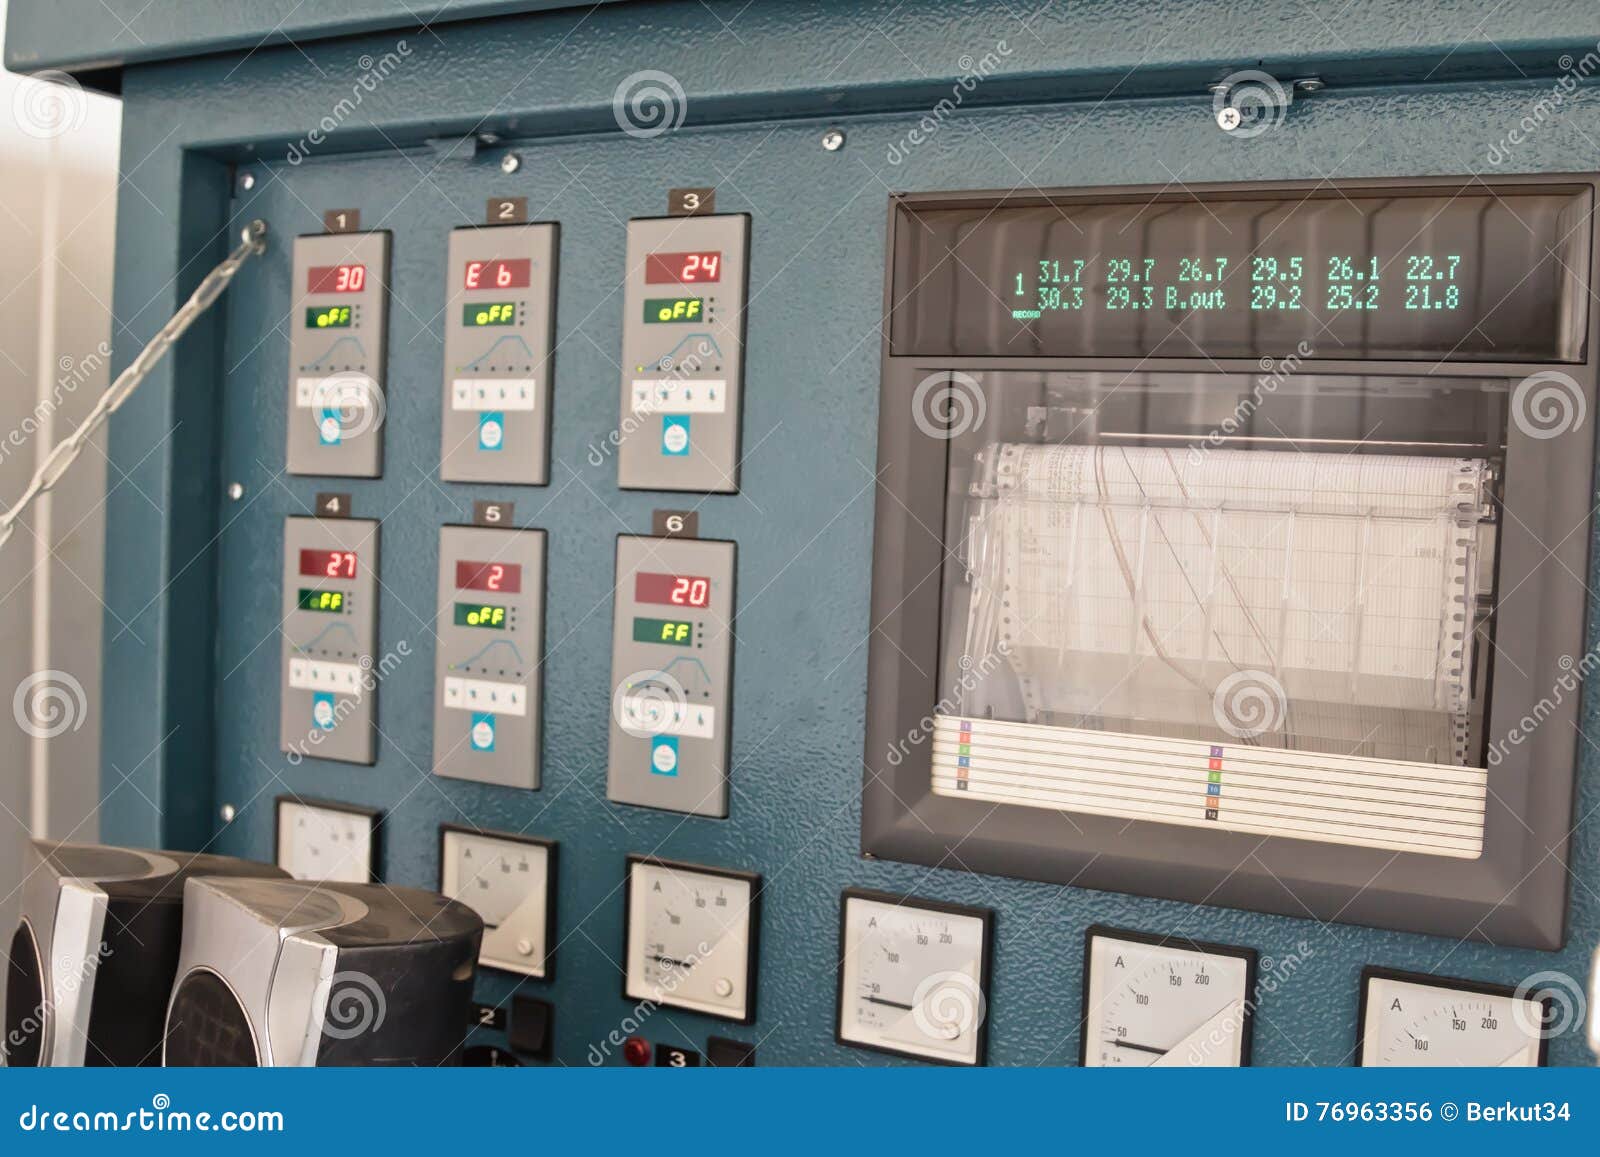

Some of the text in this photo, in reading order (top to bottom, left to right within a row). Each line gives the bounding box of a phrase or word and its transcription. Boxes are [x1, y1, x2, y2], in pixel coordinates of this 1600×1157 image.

[683, 193, 700, 209] 3
[499, 202, 515, 219] 2
[336, 213, 346, 229] 1
[682, 255, 718, 280] 24
[1038, 255, 1460, 283] 31.7 29.7 26.7 29.5 26.1 22.7
[336, 266, 364, 292] 30
[1015, 272, 1024, 296] 1
[1037, 285, 1459, 310] 30.3 29.3 B.out 29.2 25.2 21.8
[1012, 310, 1041, 319] RECORD
[325, 496, 340, 512] 4
[485, 505, 501, 522] 5
[666, 515, 684, 532] 6
[327, 552, 356, 577] 27
[487, 565, 504, 590] 2
[672, 578, 707, 605] 20
[661, 623, 689, 641] FF
[653, 880, 662, 893] A
[868, 916, 877, 928] A
[916, 933, 953, 945] 150 200
[888, 952, 899, 963] 100
[1114, 955, 1125, 968] A
[1170, 974, 1209, 986] 150 200
[871, 983, 880, 994] 50
[1136, 994, 1149, 1005] 100
[1391, 998, 1402, 1012] A
[480, 1008, 495, 1025] 2
[1452, 1017, 1497, 1031] 150 200
[1117, 1026, 1127, 1037] 50
[1414, 1039, 1428, 1051] 100
[670, 1051, 686, 1067] 3
